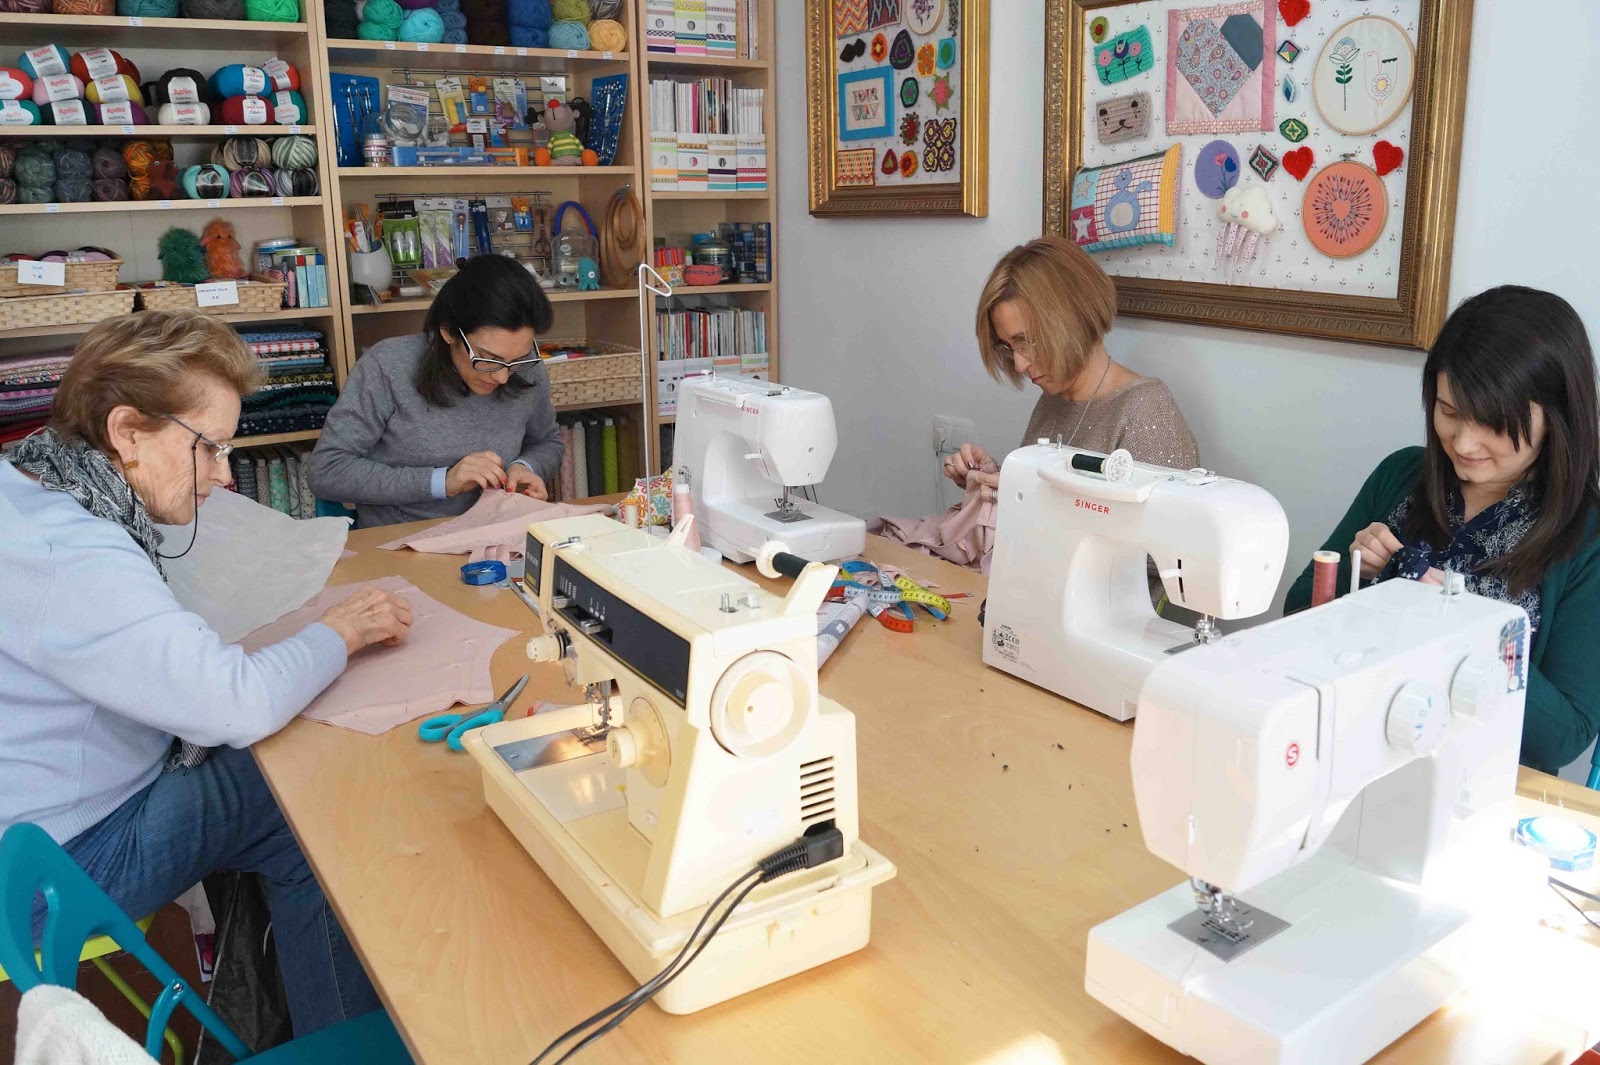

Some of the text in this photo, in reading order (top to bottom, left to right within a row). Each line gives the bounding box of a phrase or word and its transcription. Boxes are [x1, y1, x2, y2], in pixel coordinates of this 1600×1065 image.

[852, 87, 878, 104] YOUR
[851, 102, 879, 121] WAY
[741, 405, 759, 415] SINGER
[1075, 499, 1110, 514] SINGER
